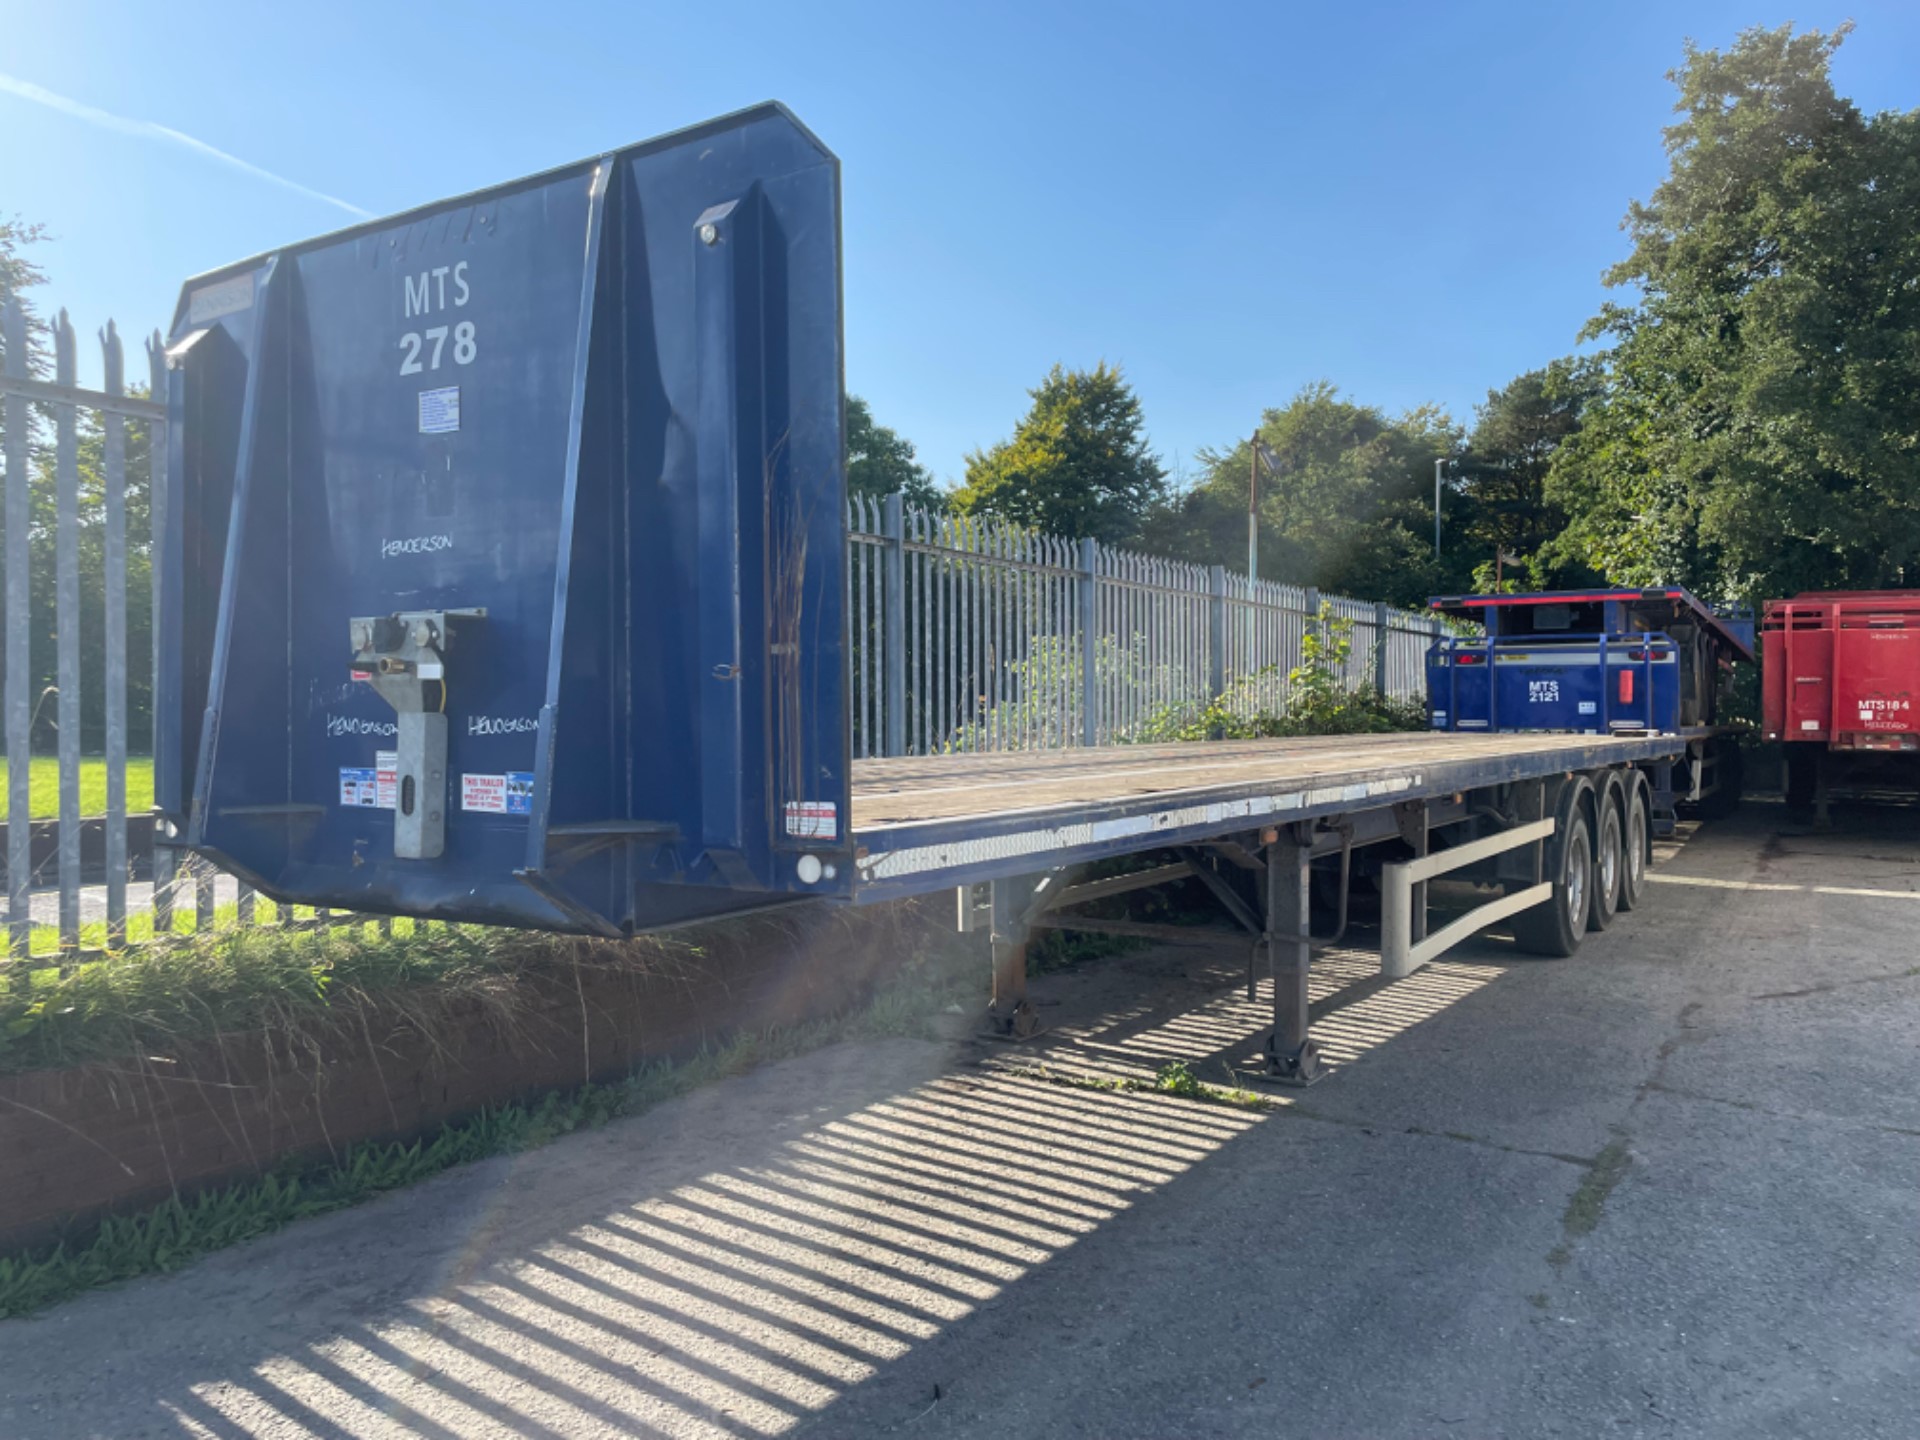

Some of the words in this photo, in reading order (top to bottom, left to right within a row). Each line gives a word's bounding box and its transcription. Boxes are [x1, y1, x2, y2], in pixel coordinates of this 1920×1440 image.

[404, 260, 470, 318] MTS
[399, 321, 477, 376] 278
[381, 532, 453, 559] HENDERSON
[1529, 680, 1559, 692] MTS
[1529, 691, 1559, 702] 2121
